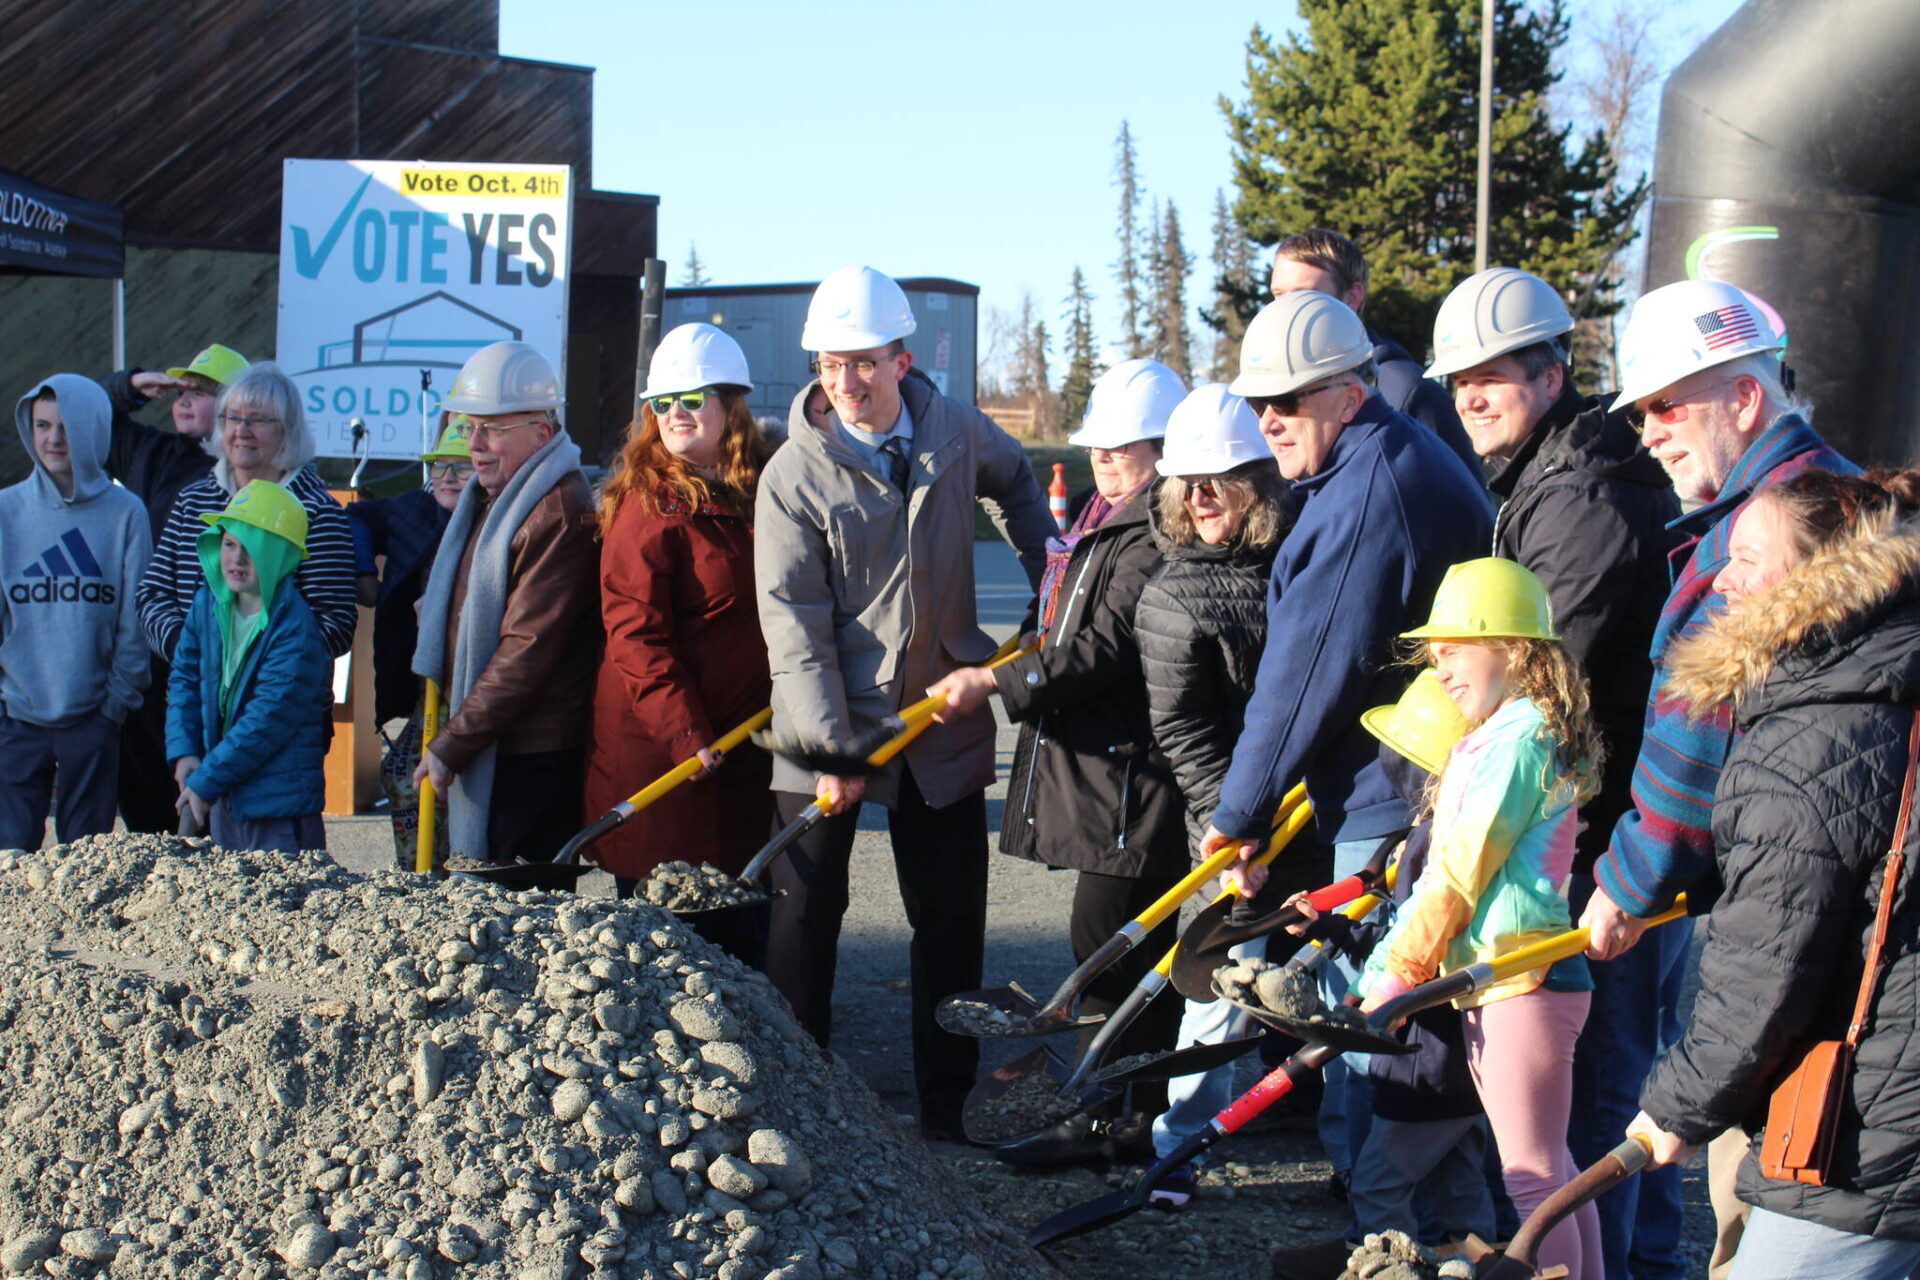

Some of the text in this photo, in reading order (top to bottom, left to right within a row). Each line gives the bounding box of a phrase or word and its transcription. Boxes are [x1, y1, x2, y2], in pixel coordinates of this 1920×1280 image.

[404, 173, 560, 195] Vote Oct. 4th
[462, 212, 556, 288] YES
[307, 384, 450, 418] SOLDO
[304, 420, 397, 443] FIED
[9, 575, 116, 605] adidas
